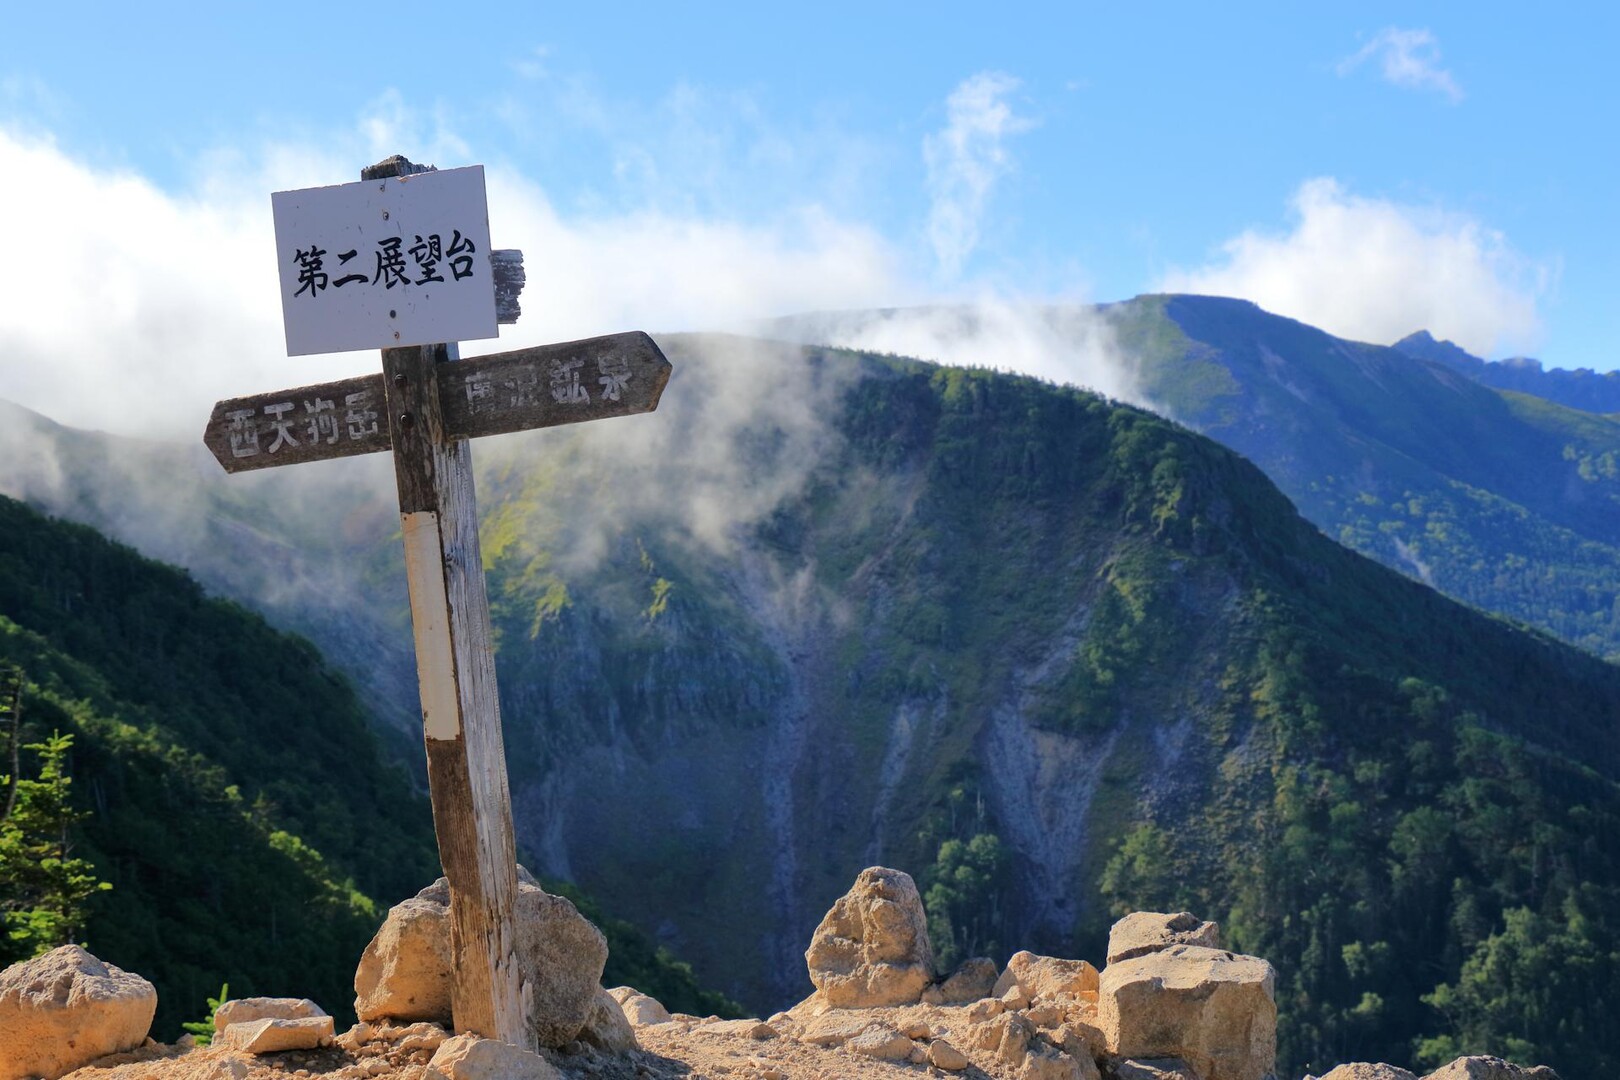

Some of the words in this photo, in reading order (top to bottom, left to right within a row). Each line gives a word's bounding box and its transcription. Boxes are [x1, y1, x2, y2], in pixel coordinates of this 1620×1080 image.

[293, 229, 476, 298] 第二展望台
